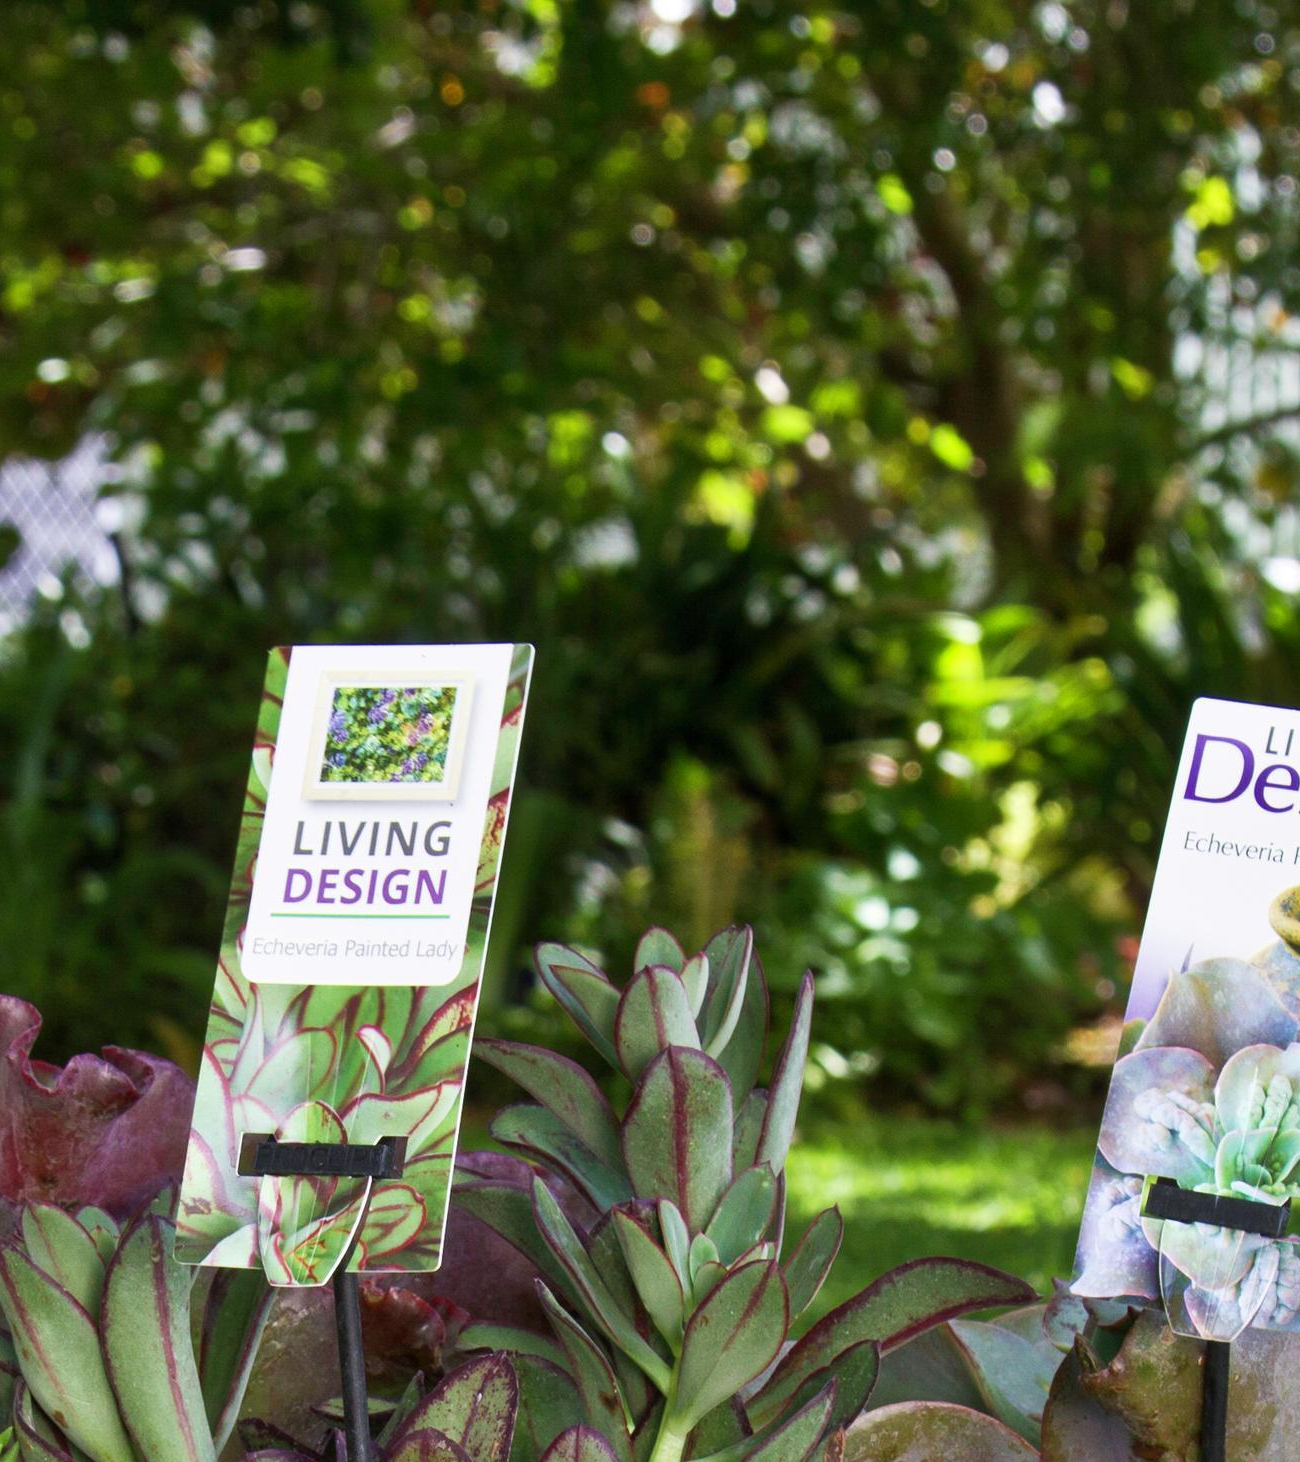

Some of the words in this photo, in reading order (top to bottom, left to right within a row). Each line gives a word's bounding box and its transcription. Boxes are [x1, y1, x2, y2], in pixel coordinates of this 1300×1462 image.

[292, 820, 453, 857] LIVING
[1183, 830, 1285, 864] Echeveria
[282, 868, 448, 905] DESIGN
[252, 937, 338, 957] Echeveria
[345, 939, 411, 958] Painted
[416, 940, 460, 960] Lady
